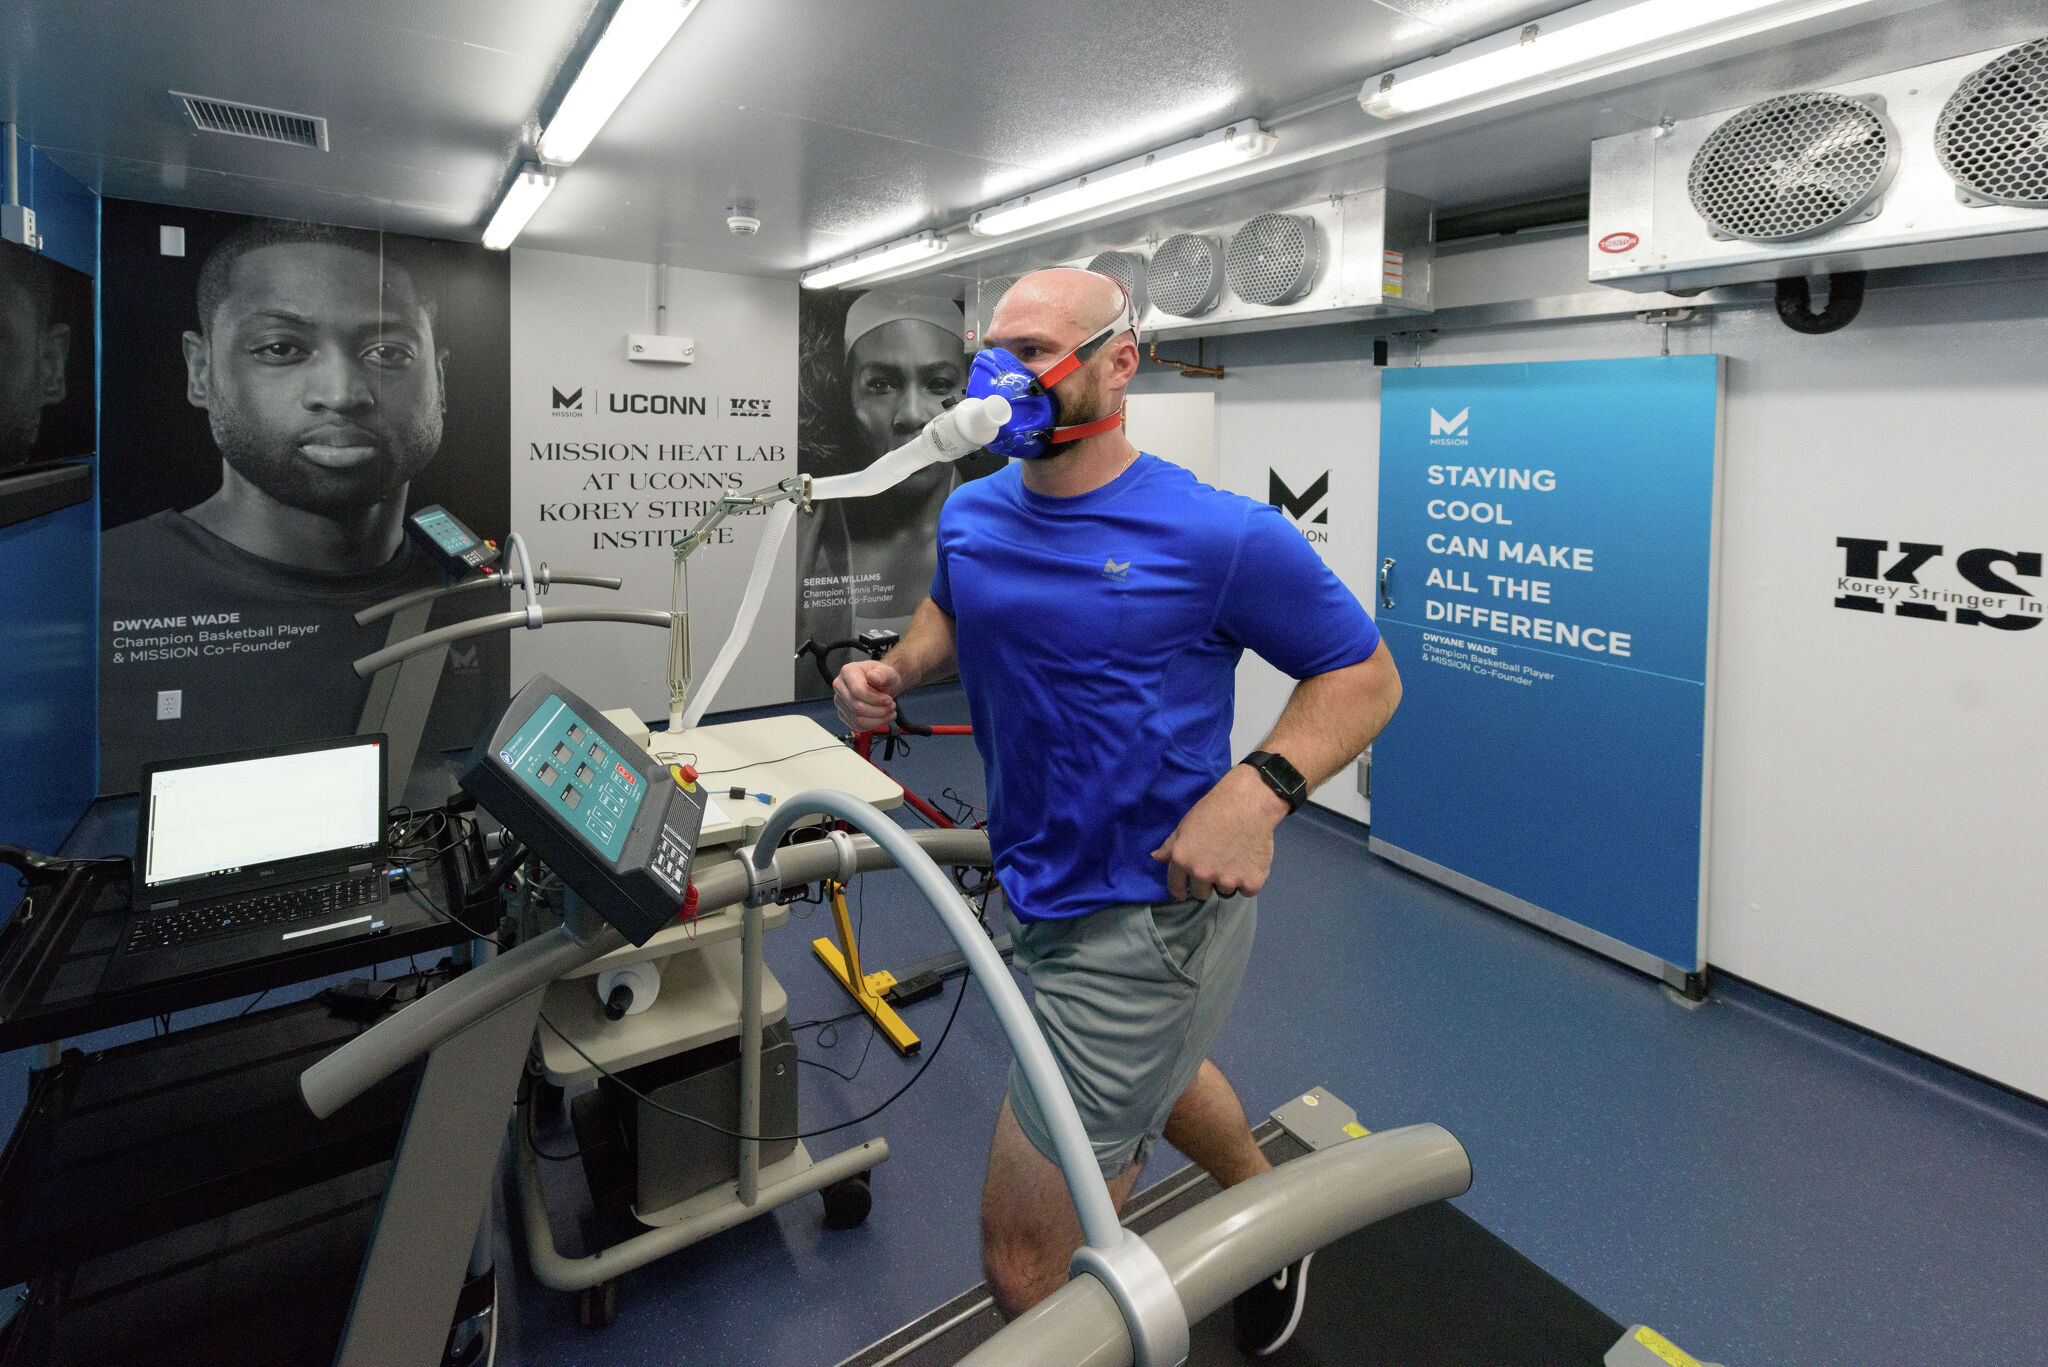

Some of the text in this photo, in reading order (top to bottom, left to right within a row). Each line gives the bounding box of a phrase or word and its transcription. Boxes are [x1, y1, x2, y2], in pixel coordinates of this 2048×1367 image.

[609, 393, 706, 416] UCONN
[729, 398, 772, 418] KSI
[529, 442, 786, 462] MISSION HEAT LAB
[1430, 438, 1468, 446] MISSION
[582, 471, 743, 491] AT UCONN'S
[1427, 464, 1557, 492] STAYING
[539, 500, 640, 522] KOREY
[1426, 498, 1513, 526] COOL
[593, 527, 734, 550] INSTITE
[1426, 533, 1595, 572] CAN MAKE
[803, 573, 881, 587] SERENA WILLIAMS
[803, 583, 895, 599] Champion Tennis Player
[1425, 567, 1551, 605] ALL THE
[803, 594, 893, 609] & MISSION Co-Founder
[1837, 576, 2048, 614] Korey Stringer In
[113, 612, 240, 632] DWYANE WADE
[1426, 599, 1632, 657] DIFFERENCE
[113, 624, 320, 649] Champion Basketball Player
[1423, 632, 1498, 656] DWYANE WADE
[113, 640, 292, 664] & MISSION Co-Founder
[1422, 643, 1555, 681] Champion Basketball Player
[1422, 652, 1533, 686] & MISSION Co-Founder
